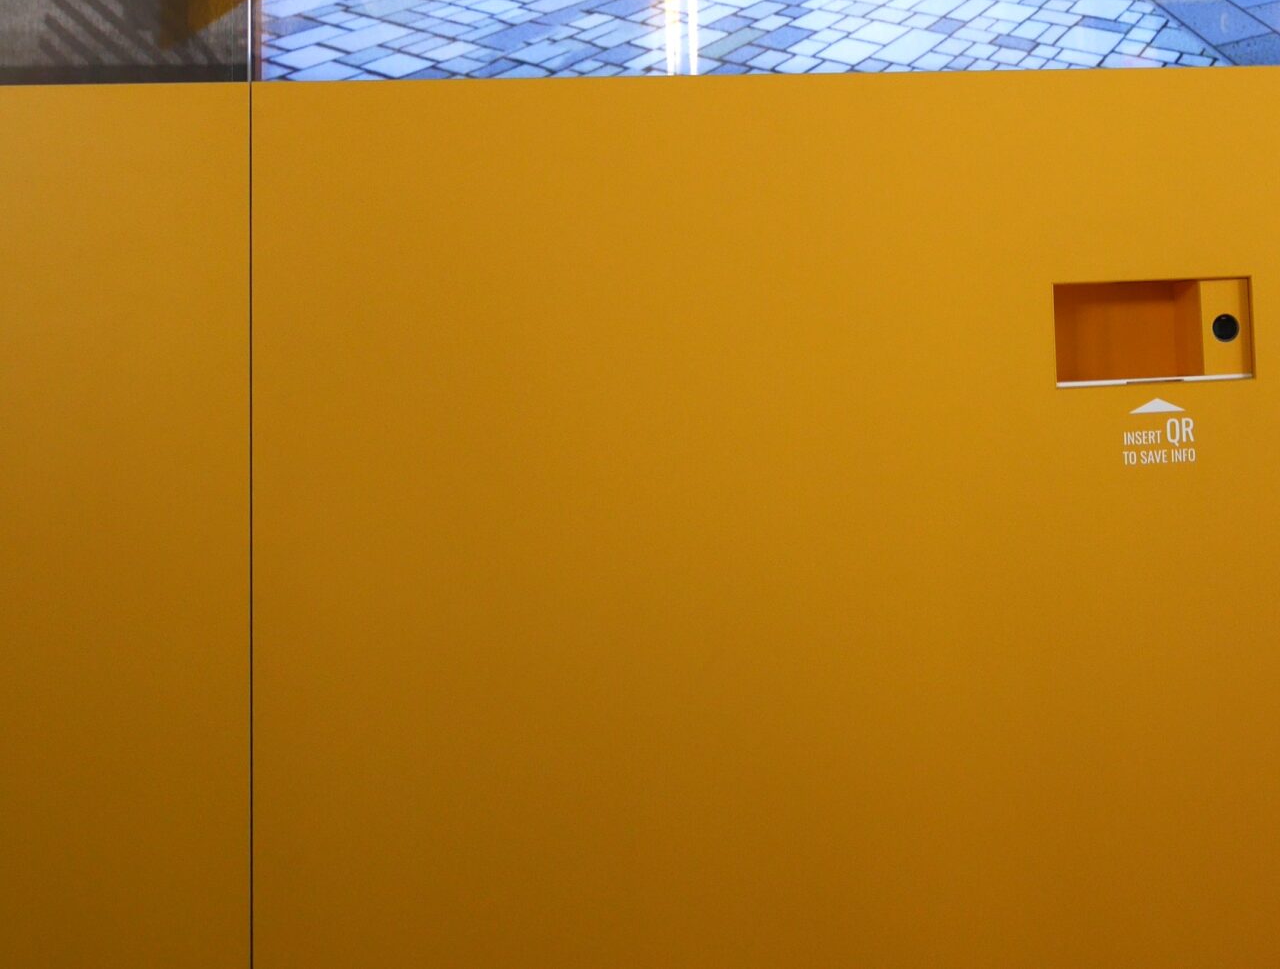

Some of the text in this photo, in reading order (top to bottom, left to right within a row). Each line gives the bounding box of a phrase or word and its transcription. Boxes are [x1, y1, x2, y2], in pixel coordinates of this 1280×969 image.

[1123, 417, 1195, 447] INSERT QR
[1122, 447, 1196, 465] TO SAVE INFO
